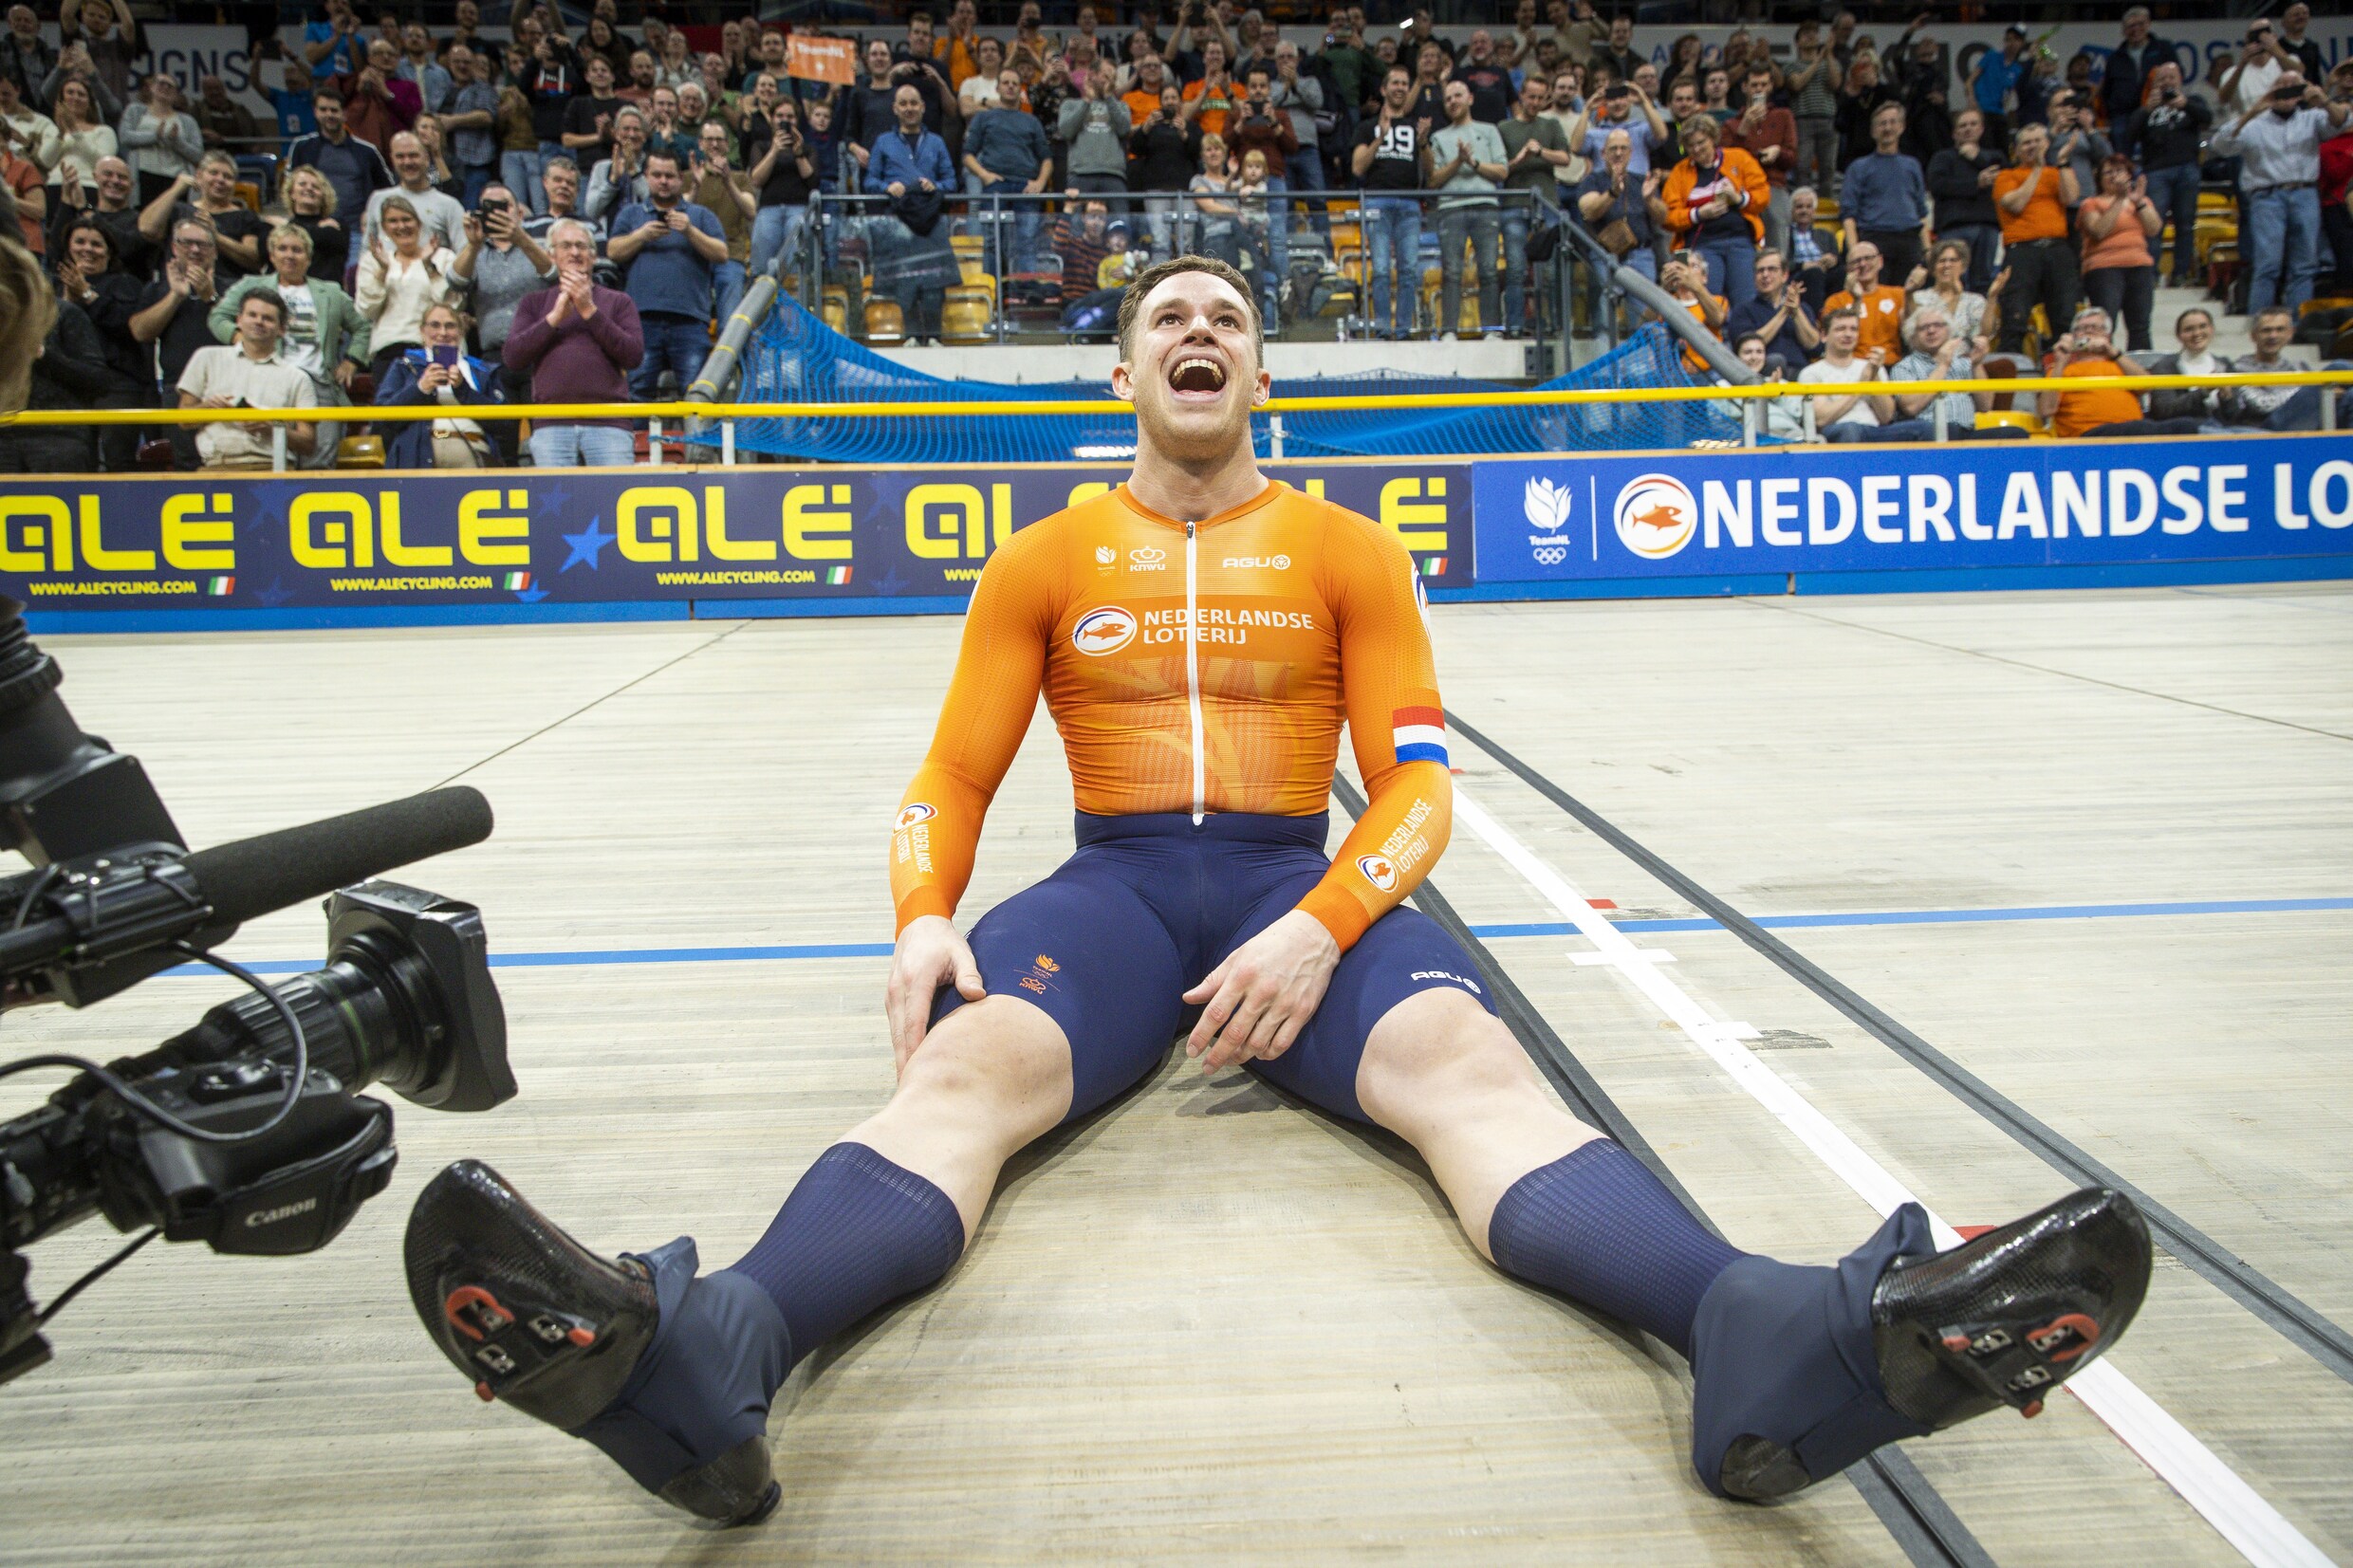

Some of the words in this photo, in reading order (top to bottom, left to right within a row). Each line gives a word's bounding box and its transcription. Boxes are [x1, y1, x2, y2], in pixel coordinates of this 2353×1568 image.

[1703, 465, 2249, 548] NEDERLANDSE
[2274, 459, 2353, 529] LO
[1529, 534, 1570, 545] TeamNL
[1223, 557, 1271, 568] AGU
[330, 577, 492, 591] WWW.ALECYCLING.COM
[657, 570, 816, 585] WWW.ALECYCLING.COM
[28, 581, 197, 595] WWW.ALECYCLING.COM
[1144, 608, 1315, 630] NEDERLANDSE
[1143, 627, 1247, 645] LOTERIJ
[1379, 798, 1433, 858] NEDERLANDSE
[1395, 834, 1430, 874] LOTERIJ
[1411, 970, 1462, 983] AGU
[245, 1197, 317, 1227] Canon
